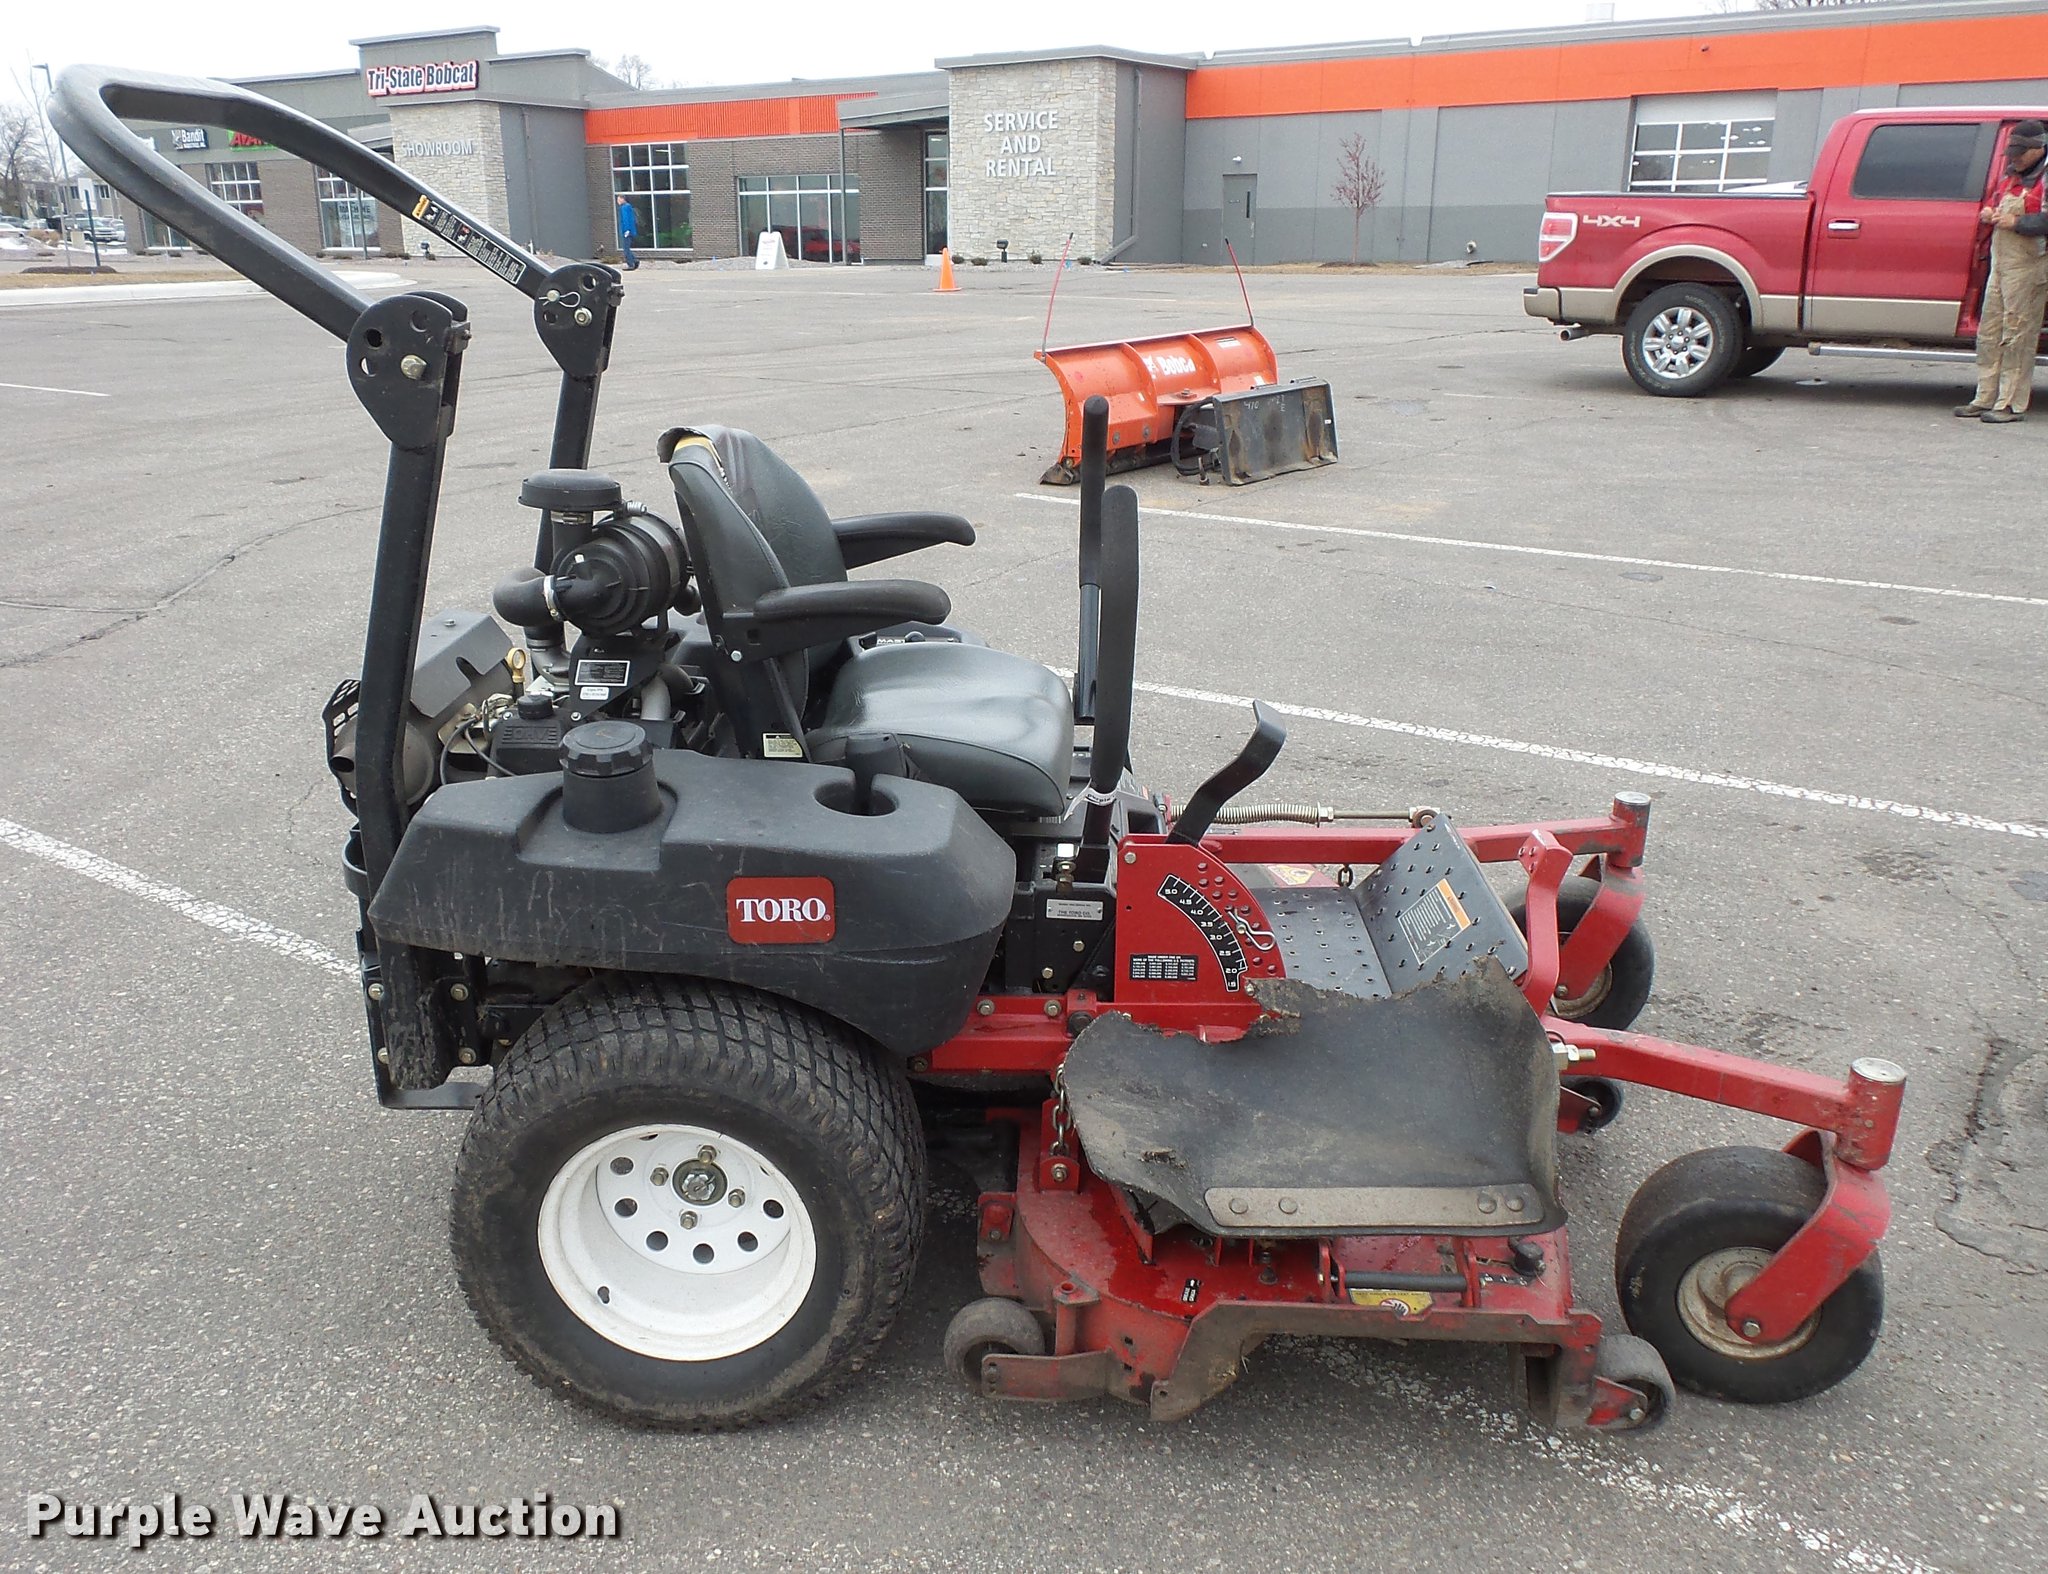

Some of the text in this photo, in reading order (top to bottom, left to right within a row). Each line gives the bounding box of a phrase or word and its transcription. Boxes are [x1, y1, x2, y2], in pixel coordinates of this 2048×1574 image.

[367, 62, 475, 91] Tri-State Bobcat
[984, 110, 1058, 132] SERVICE
[181, 128, 205, 143] Bandit
[1001, 134, 1042, 154] AND
[401, 140, 474, 157] SHOWROOM
[986, 157, 1057, 177] RENTAL
[735, 897, 827, 923] TORO
